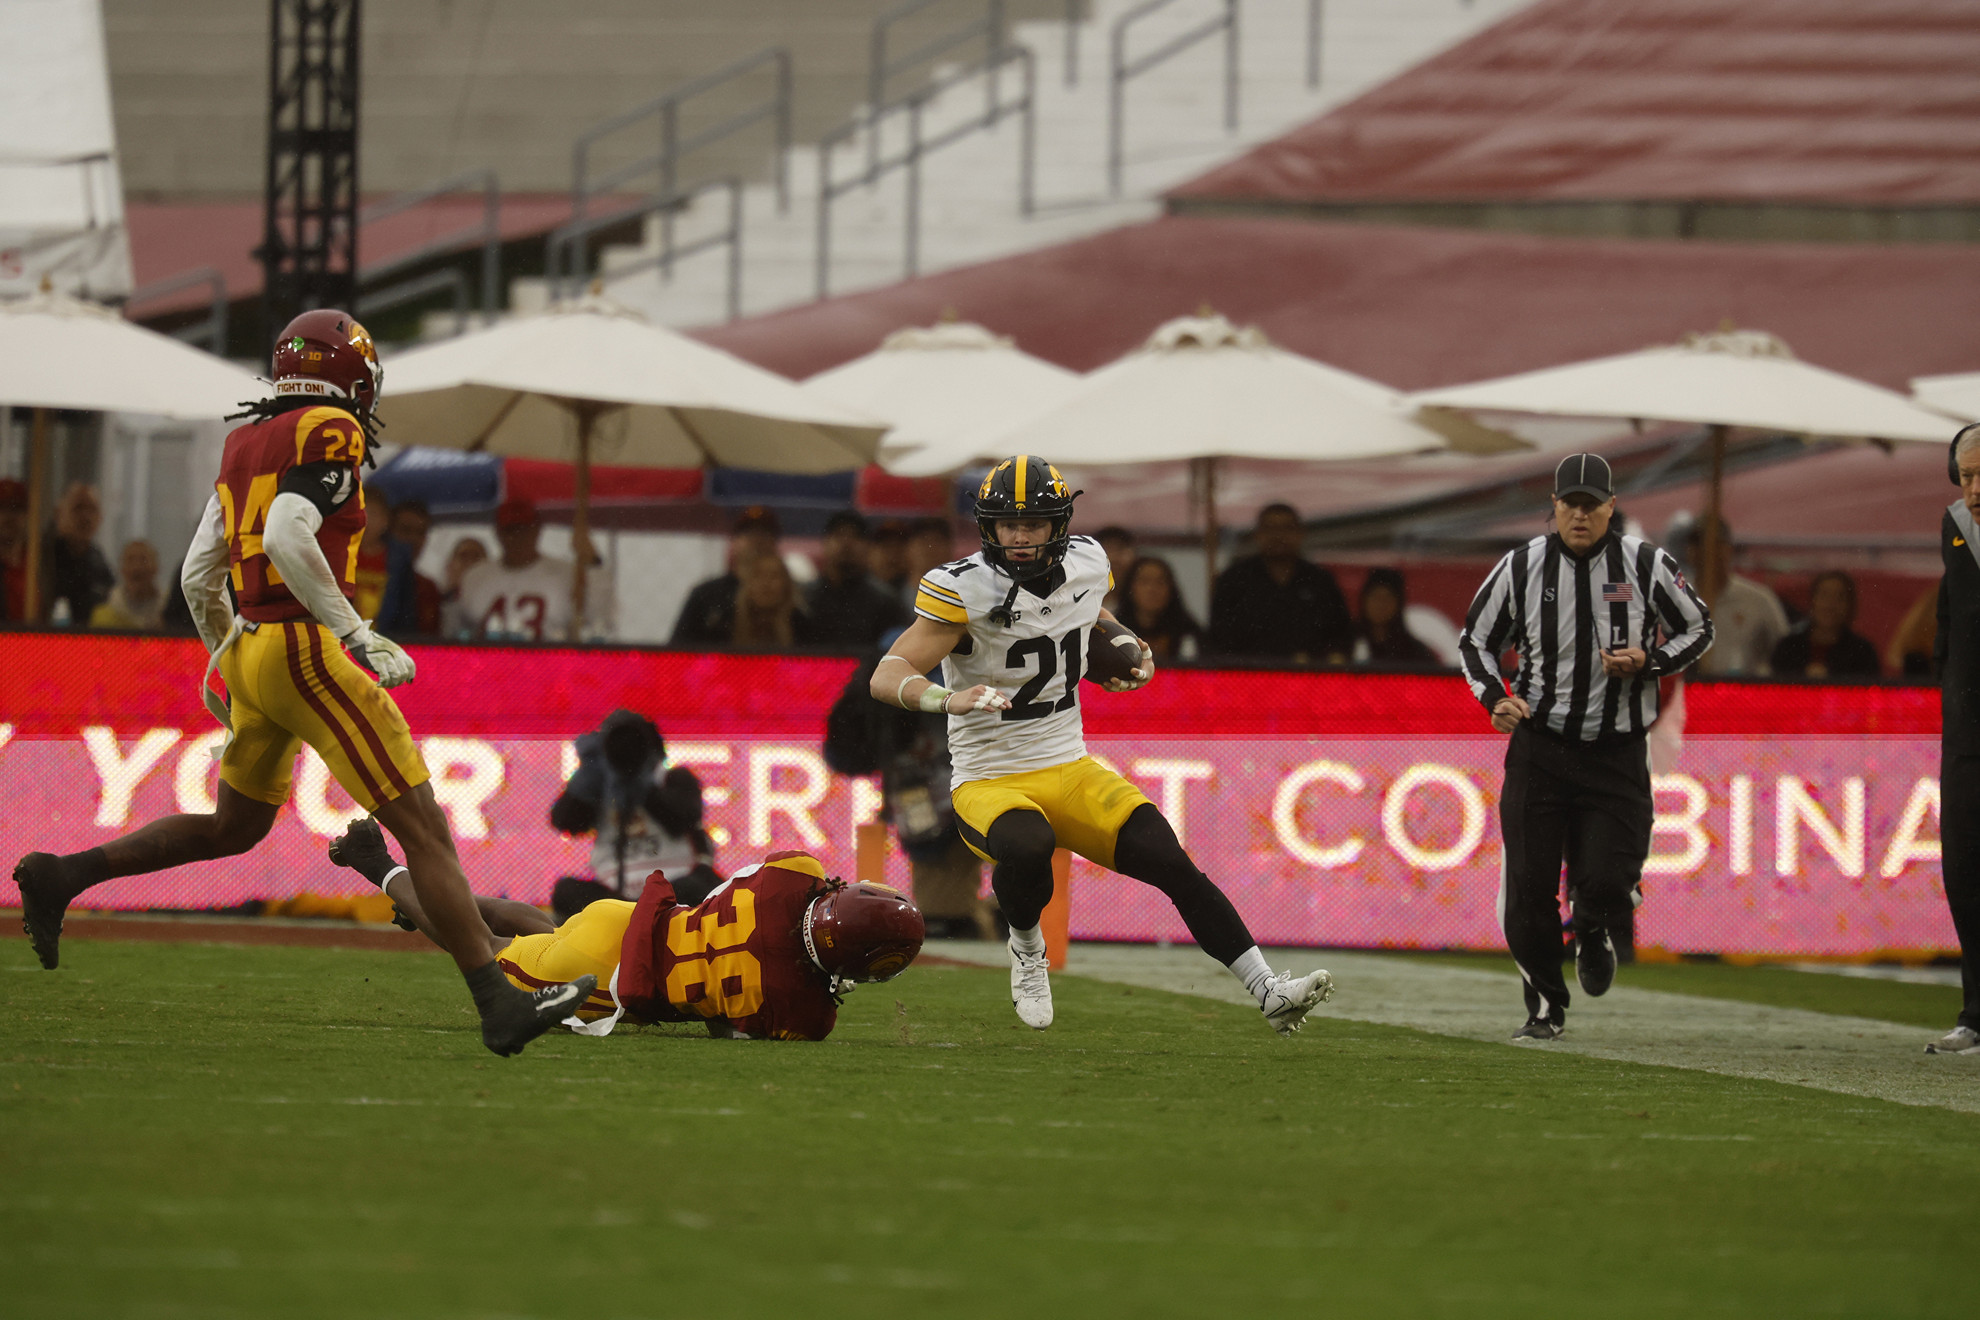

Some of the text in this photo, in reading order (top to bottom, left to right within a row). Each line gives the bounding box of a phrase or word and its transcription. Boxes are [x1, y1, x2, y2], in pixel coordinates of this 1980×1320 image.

[277, 382, 325, 395] FIGHT ON!
[322, 428, 366, 467] 24
[1543, 587, 1556, 602] S
[1612, 625, 1627, 646] L
[1001, 627, 1084, 721] 21
[1271, 760, 1941, 878] COBINA
[666, 887, 764, 1019] 38
